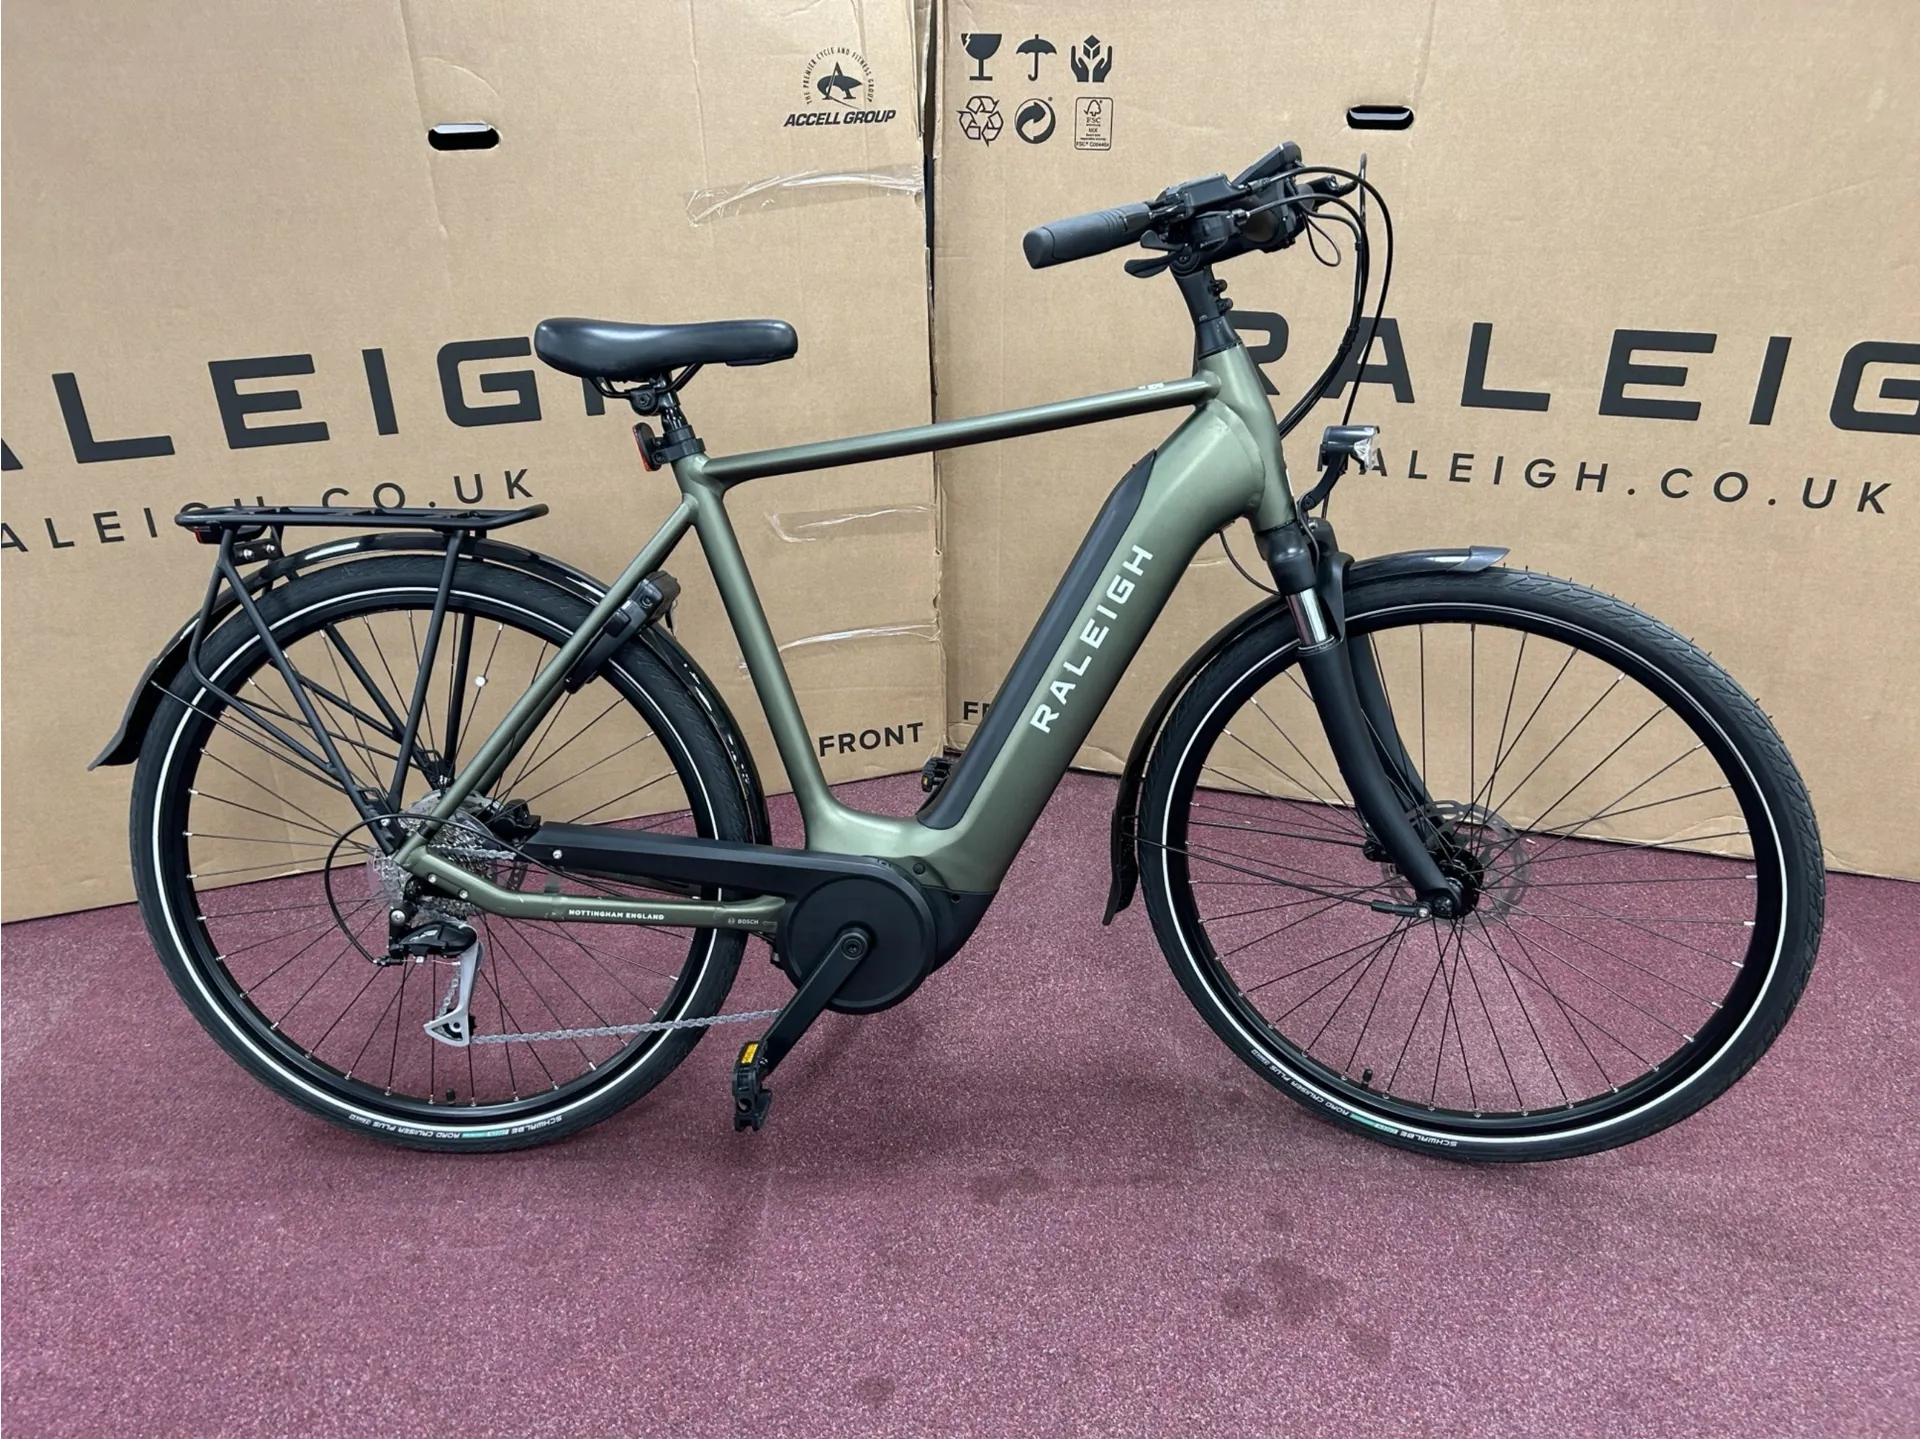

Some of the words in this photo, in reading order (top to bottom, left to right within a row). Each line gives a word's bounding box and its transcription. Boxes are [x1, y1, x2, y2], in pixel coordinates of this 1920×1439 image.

[803, 58, 817, 89] PREMIER
[816, 46, 835, 60] CYCLE
[837, 46, 850, 56] AND
[851, 51, 872, 77] FITNESS
[867, 78, 875, 103] GROUP
[784, 110, 841, 128] ACCELL
[843, 109, 897, 126] GROUP
[0, 336, 606, 471] LEIG
[1029, 544, 1154, 734] RALEIGH
[818, 721, 925, 758] FRONT
[568, 909, 624, 919] NOTTINGHAM
[625, 912, 665, 921] ENGLAND
[1268, 1064, 1289, 1081] PLUS
[1290, 1080, 1325, 1104] CRUISER
[1324, 1101, 1351, 1116] ROAD
[372, 1121, 396, 1133] PLUS
[396, 1127, 434, 1138] CRUISER
[511, 1114, 563, 1135] SCHWALBE
[435, 1131, 461, 1139] ROAD
[1399, 1131, 1459, 1148] SCHWALBE
